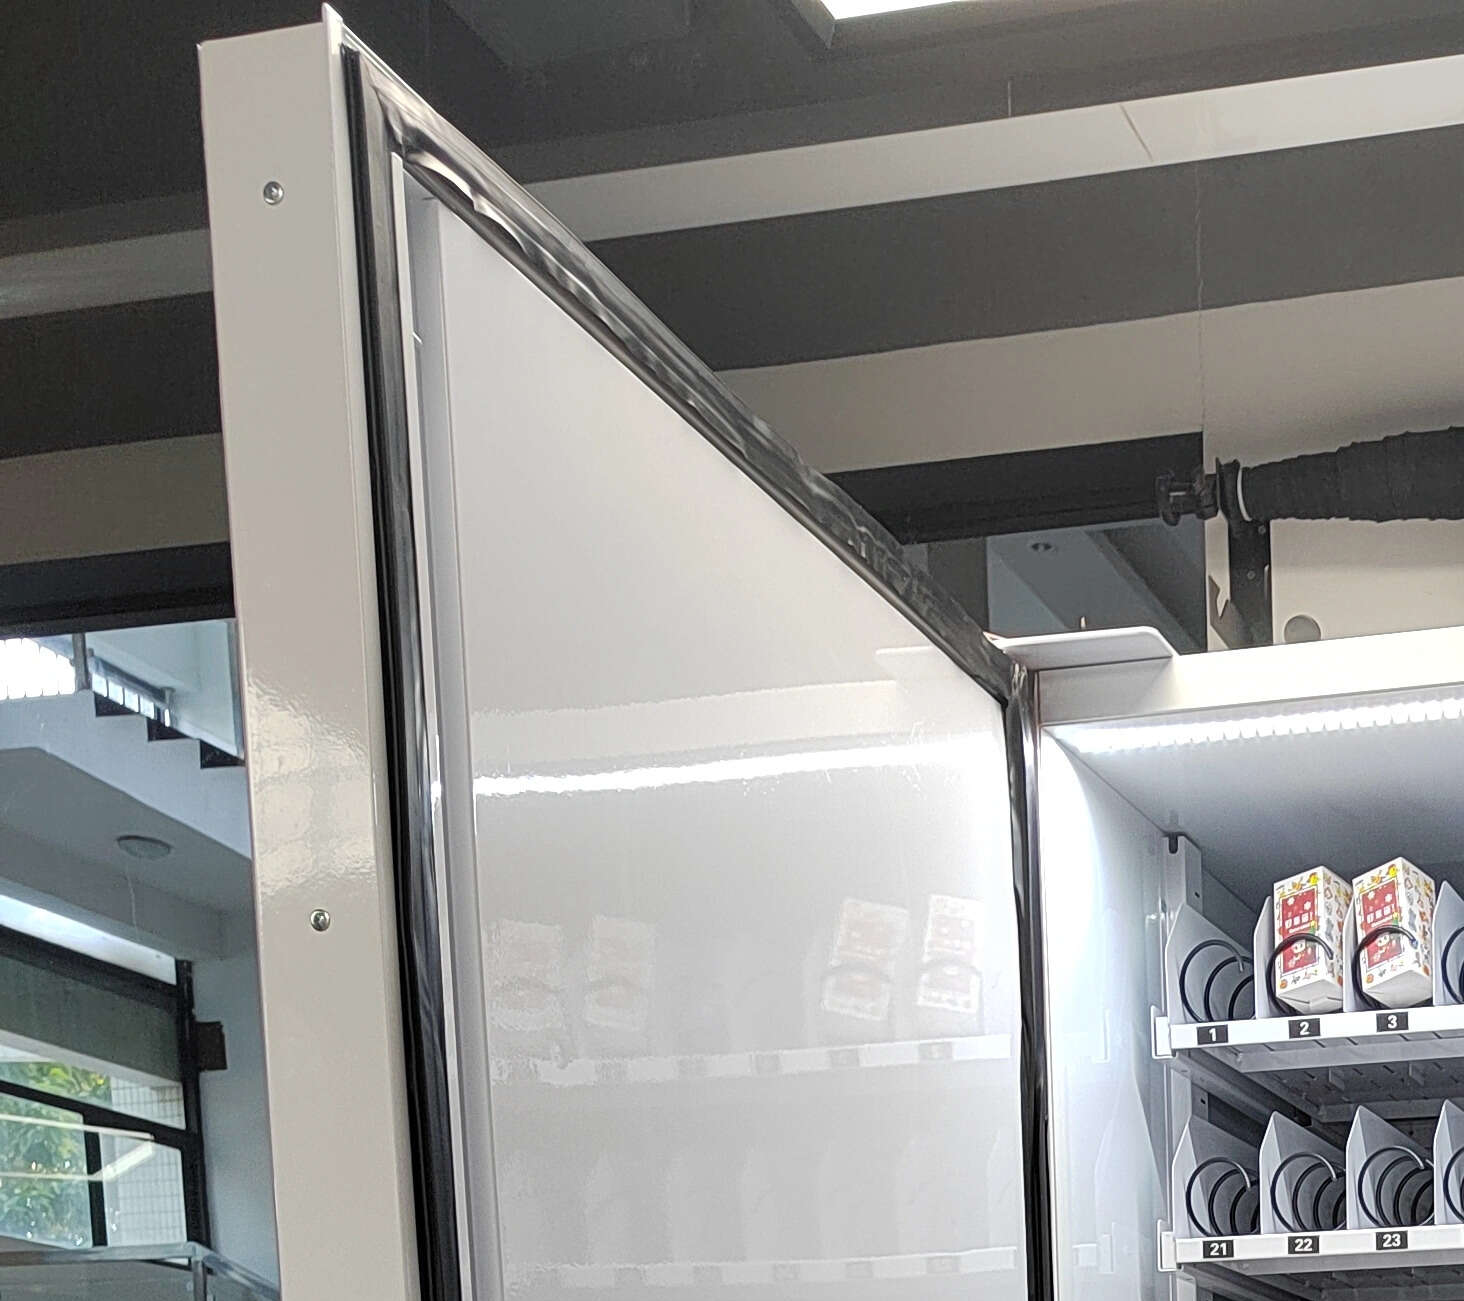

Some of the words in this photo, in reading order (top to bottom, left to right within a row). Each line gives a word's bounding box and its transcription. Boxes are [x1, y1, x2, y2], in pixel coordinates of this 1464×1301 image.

[1208, 1027, 1217, 1042] 1
[1299, 1021, 1310, 1036] 2
[1387, 1014, 1398, 1029] 3
[1209, 1242, 1227, 1256] 21
[1294, 1237, 1313, 1252] 22
[1382, 1233, 1401, 1248] 23
